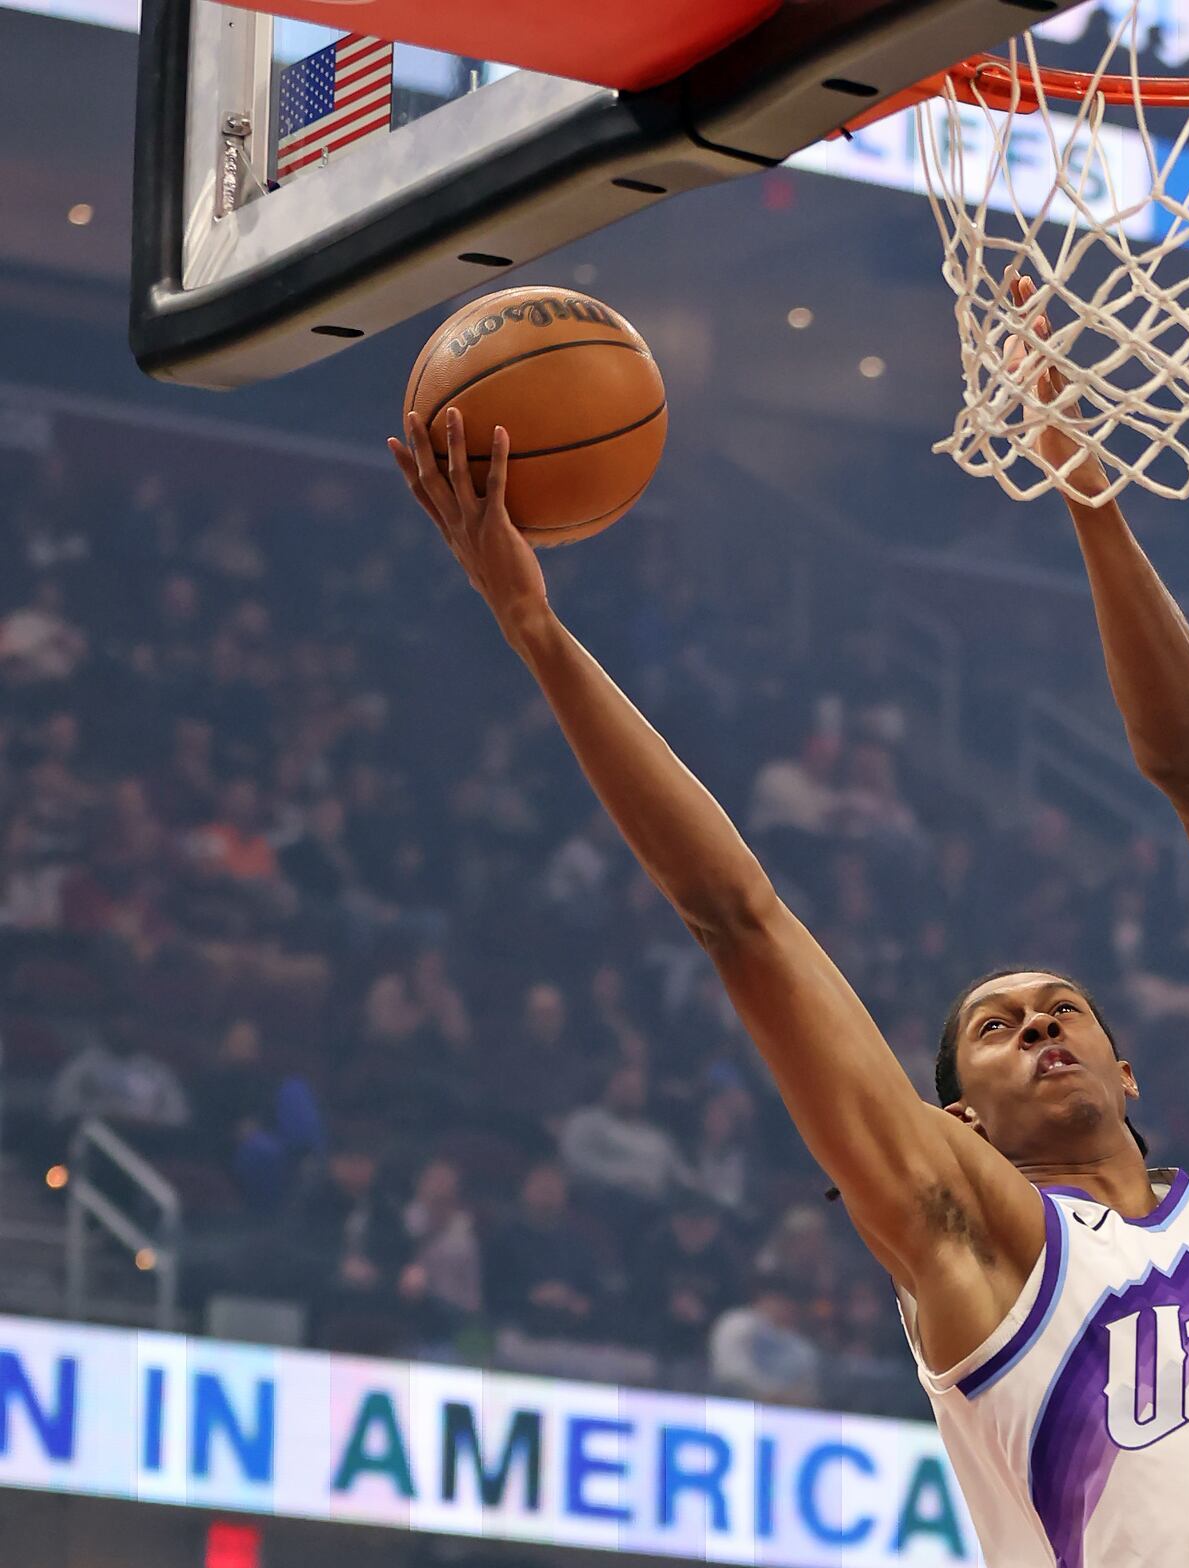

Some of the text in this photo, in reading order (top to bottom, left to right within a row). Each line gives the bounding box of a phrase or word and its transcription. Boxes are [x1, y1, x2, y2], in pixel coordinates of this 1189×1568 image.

[449, 297, 622, 358] Wilson
[145, 1368, 274, 1482] IN
[332, 1389, 966, 1560] AMERICA
